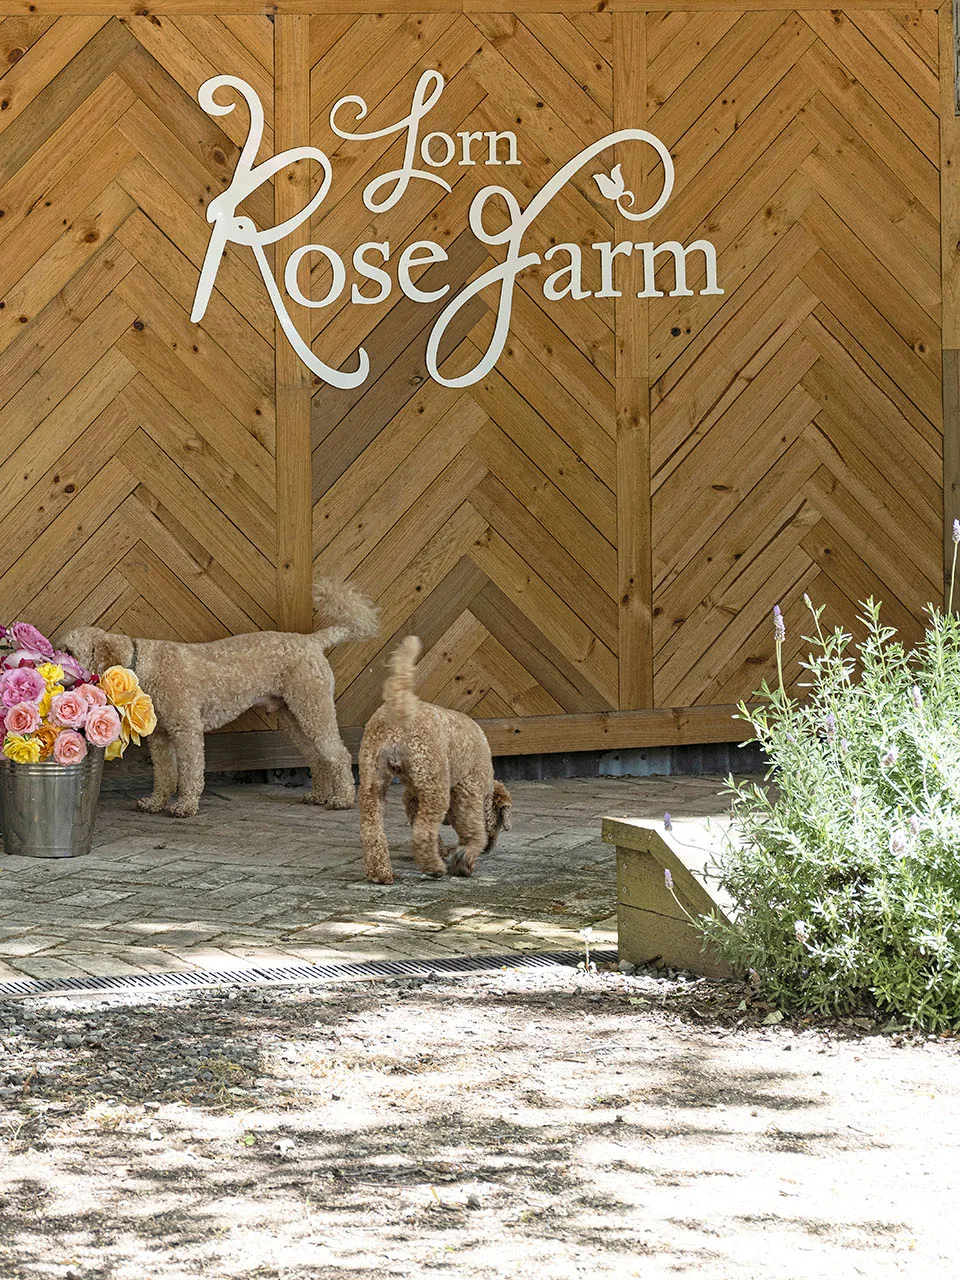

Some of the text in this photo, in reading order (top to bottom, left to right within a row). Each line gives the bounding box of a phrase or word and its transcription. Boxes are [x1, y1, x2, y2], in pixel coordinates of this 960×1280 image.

[190, 75, 725, 389] Rose Farm
[330, 69, 521, 213] Lorn
